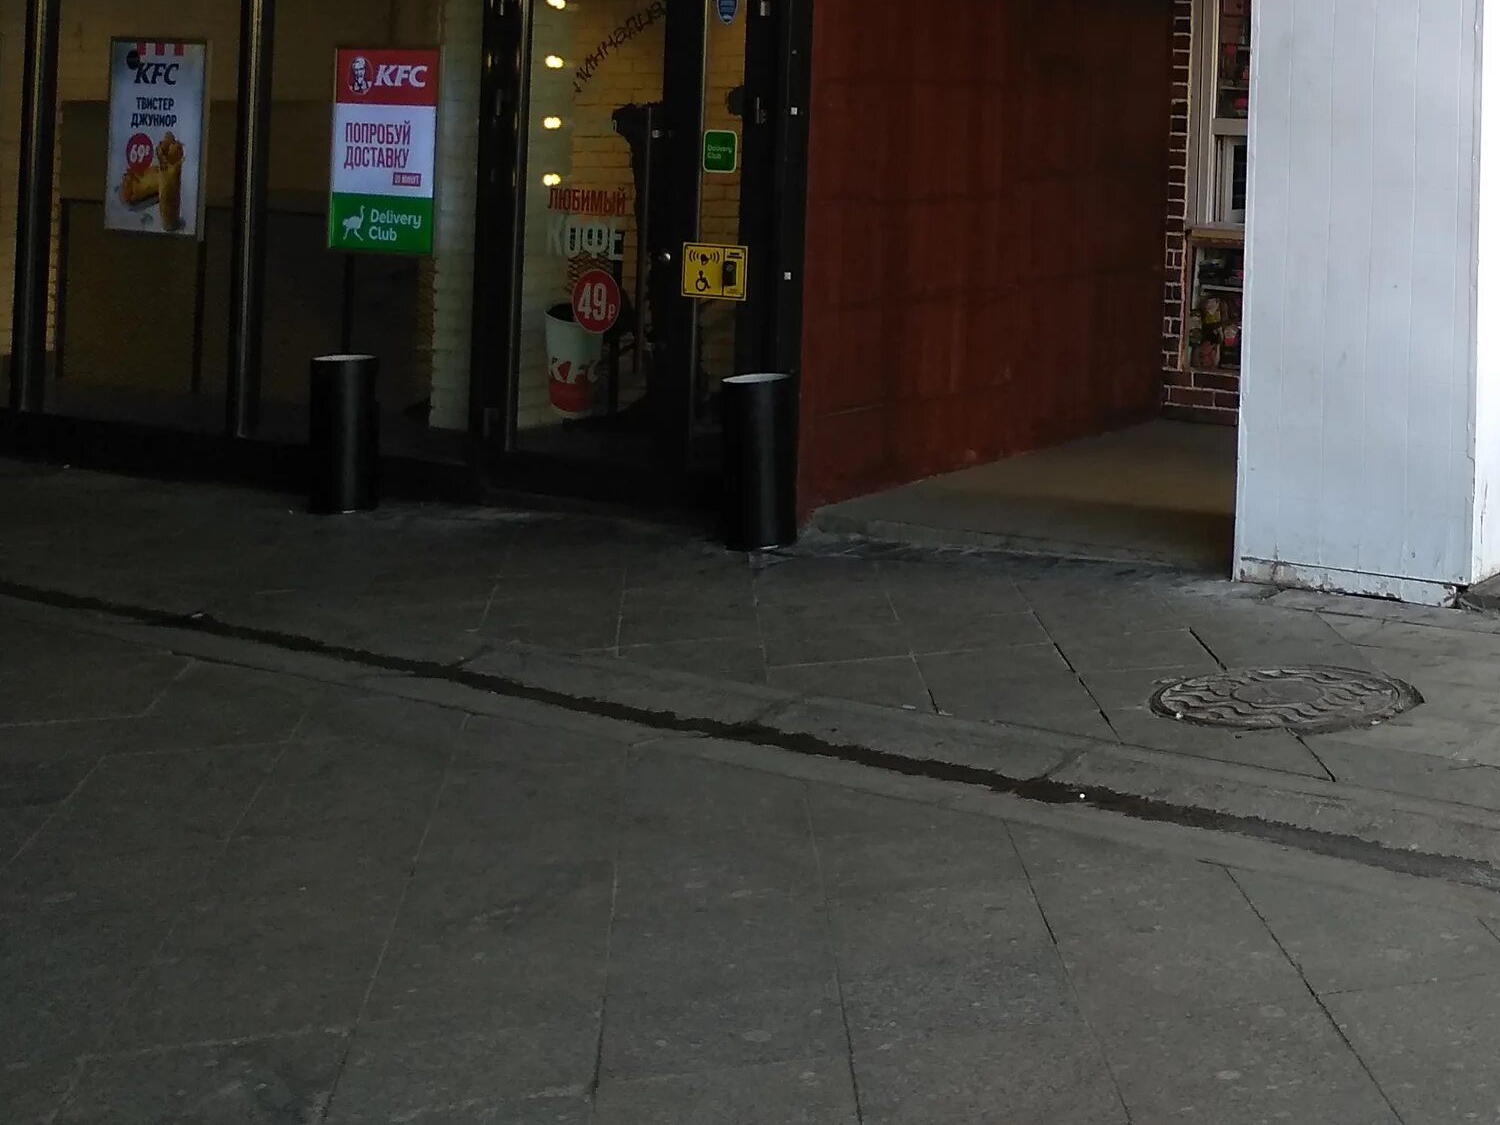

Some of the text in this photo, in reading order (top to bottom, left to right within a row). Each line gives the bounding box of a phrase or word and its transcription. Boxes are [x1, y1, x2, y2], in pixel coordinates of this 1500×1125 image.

[134, 62, 180, 86] KFC
[374, 64, 428, 88] KFC
[136, 96, 175, 111] ТВИСТЕР
[130, 113, 177, 128] ДЖУНИОР
[345, 120, 411, 146] ПОПРОБУЙ
[343, 145, 410, 170] ДОСТАВКУ
[547, 186, 627, 215] ЛЮБИМЫЙ
[370, 208, 422, 230] Delivery
[368, 226, 398, 241] Club
[547, 216, 625, 262] КОФЕ
